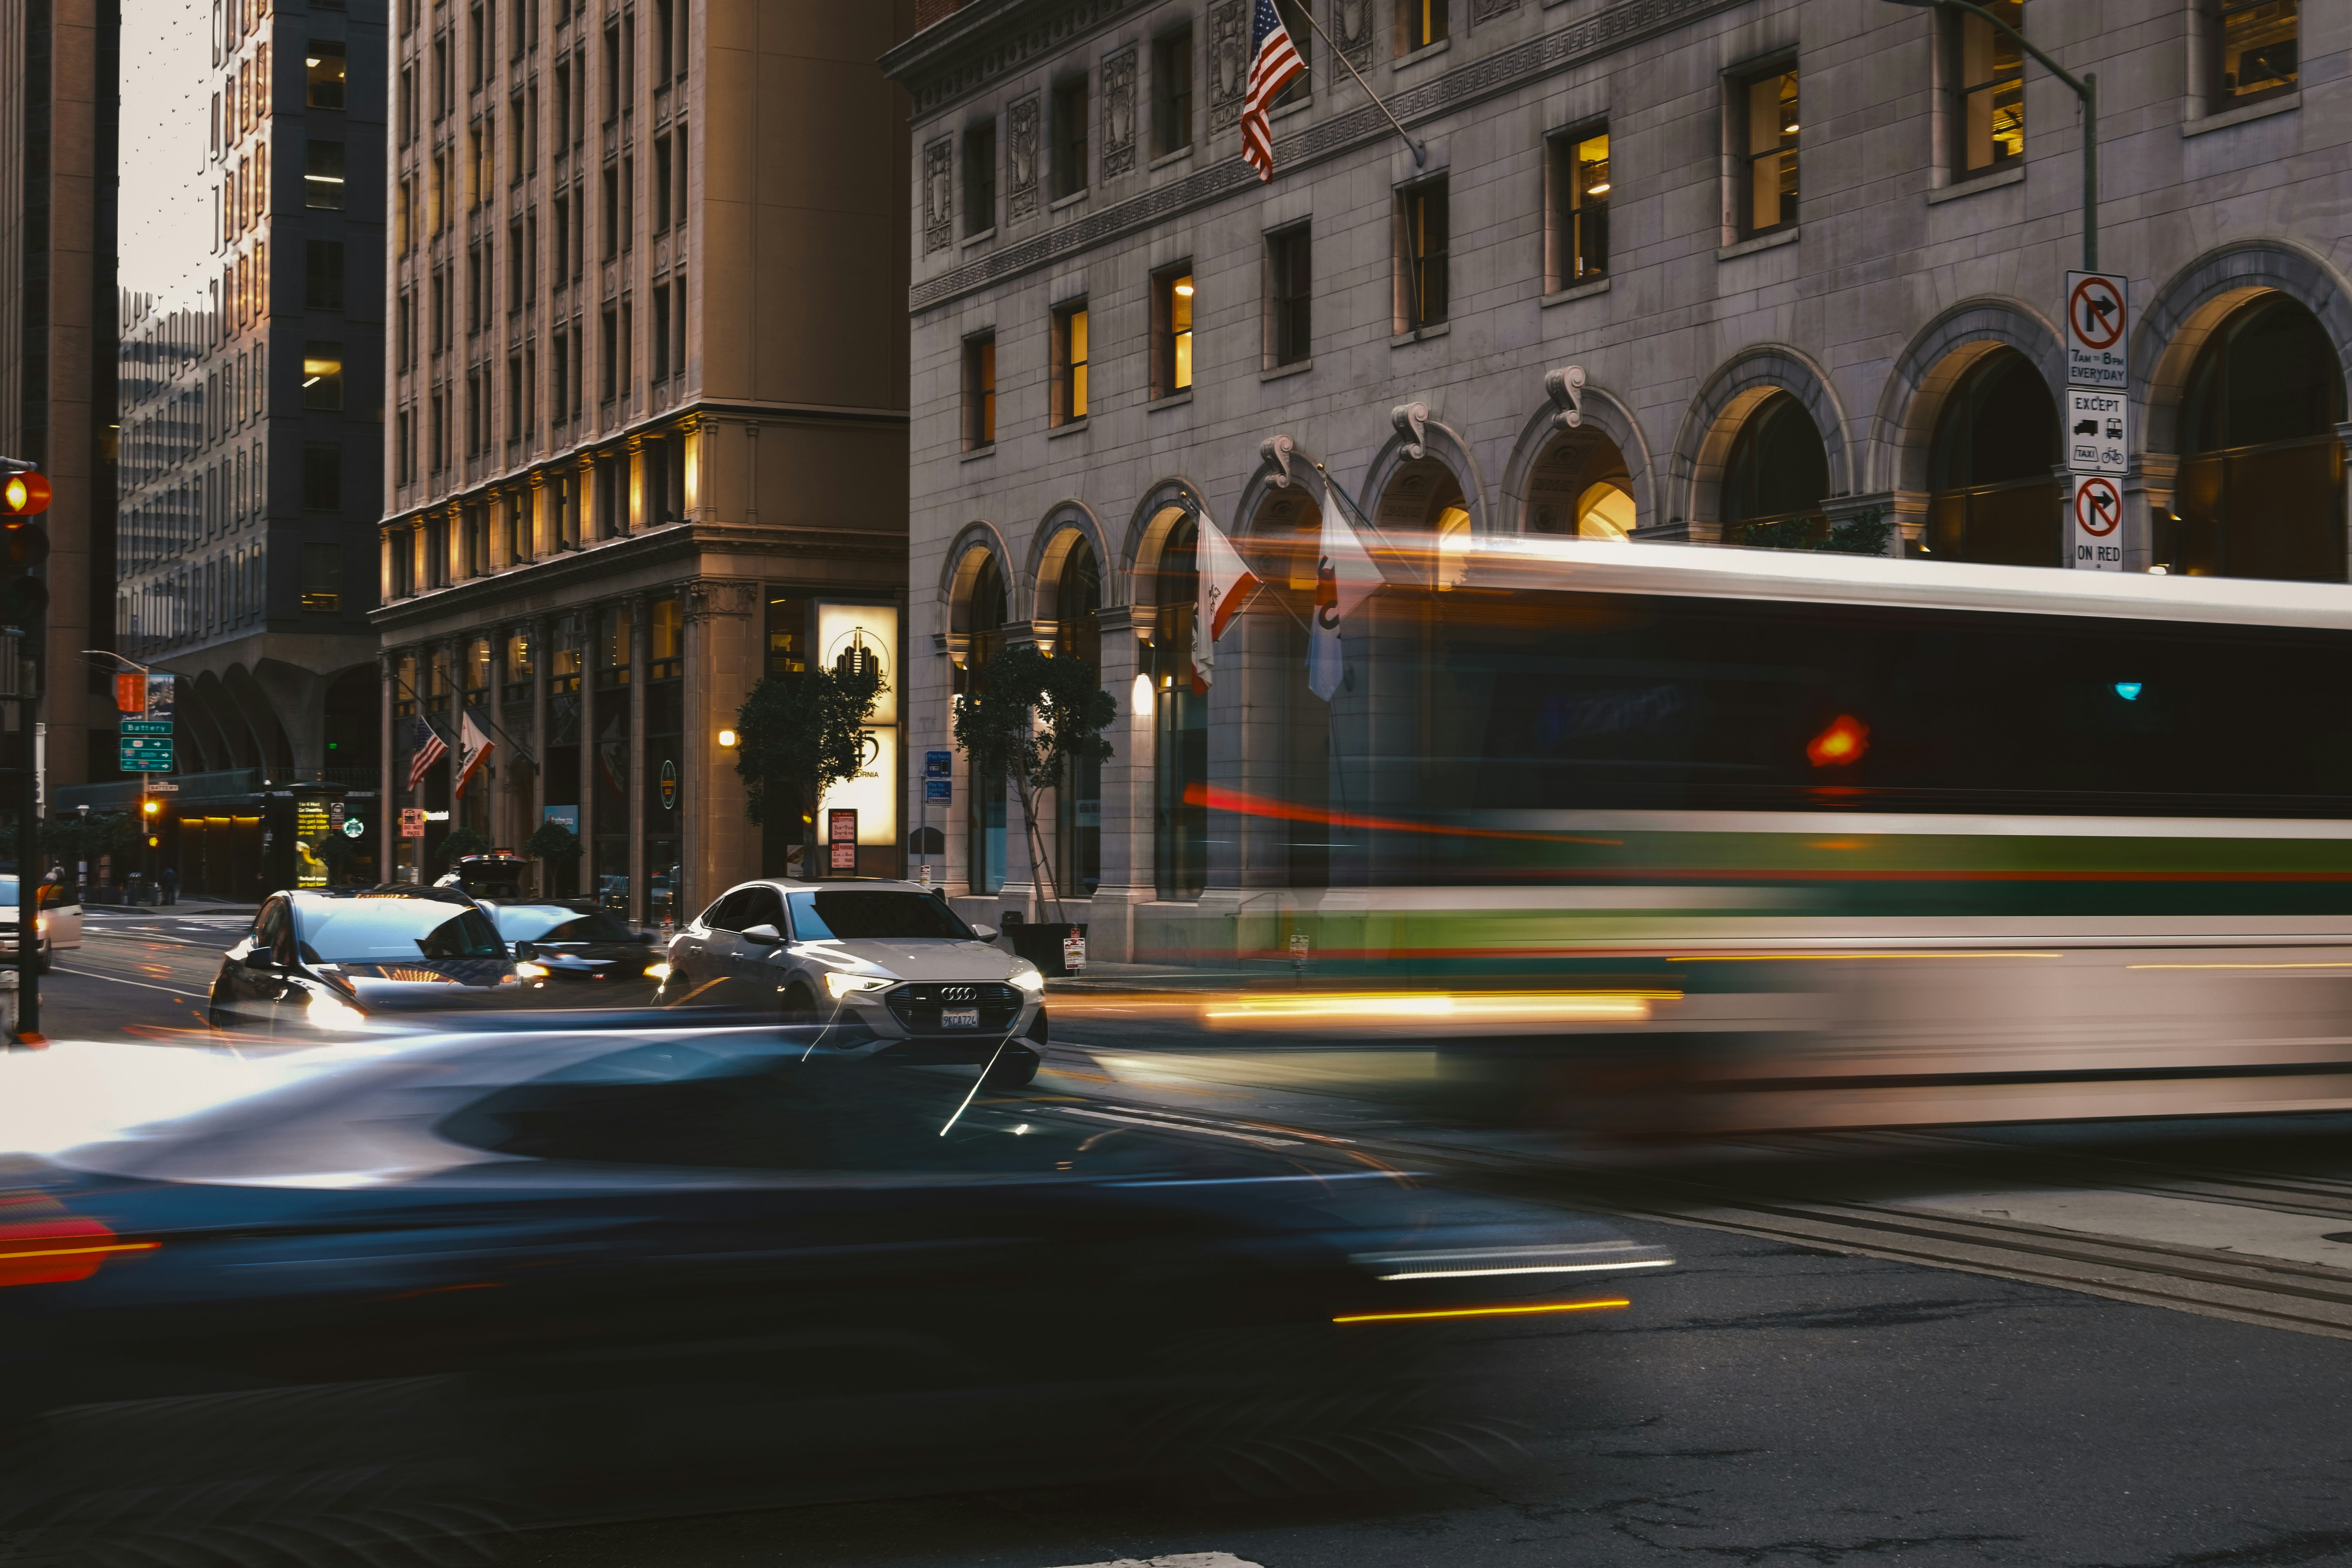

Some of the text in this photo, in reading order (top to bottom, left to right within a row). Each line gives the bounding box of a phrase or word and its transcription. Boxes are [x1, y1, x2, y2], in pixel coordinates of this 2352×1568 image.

[2070, 349, 2091, 362] 7AM
[2103, 352, 2123, 366] 8PM
[2071, 366, 2124, 381] EVERYDAY
[2076, 397, 2119, 412] EXCEPT
[2077, 449, 2095, 458] TAXI
[2078, 545, 2120, 561] ON RED
[944, 1015, 976, 1025] 9KCA724
